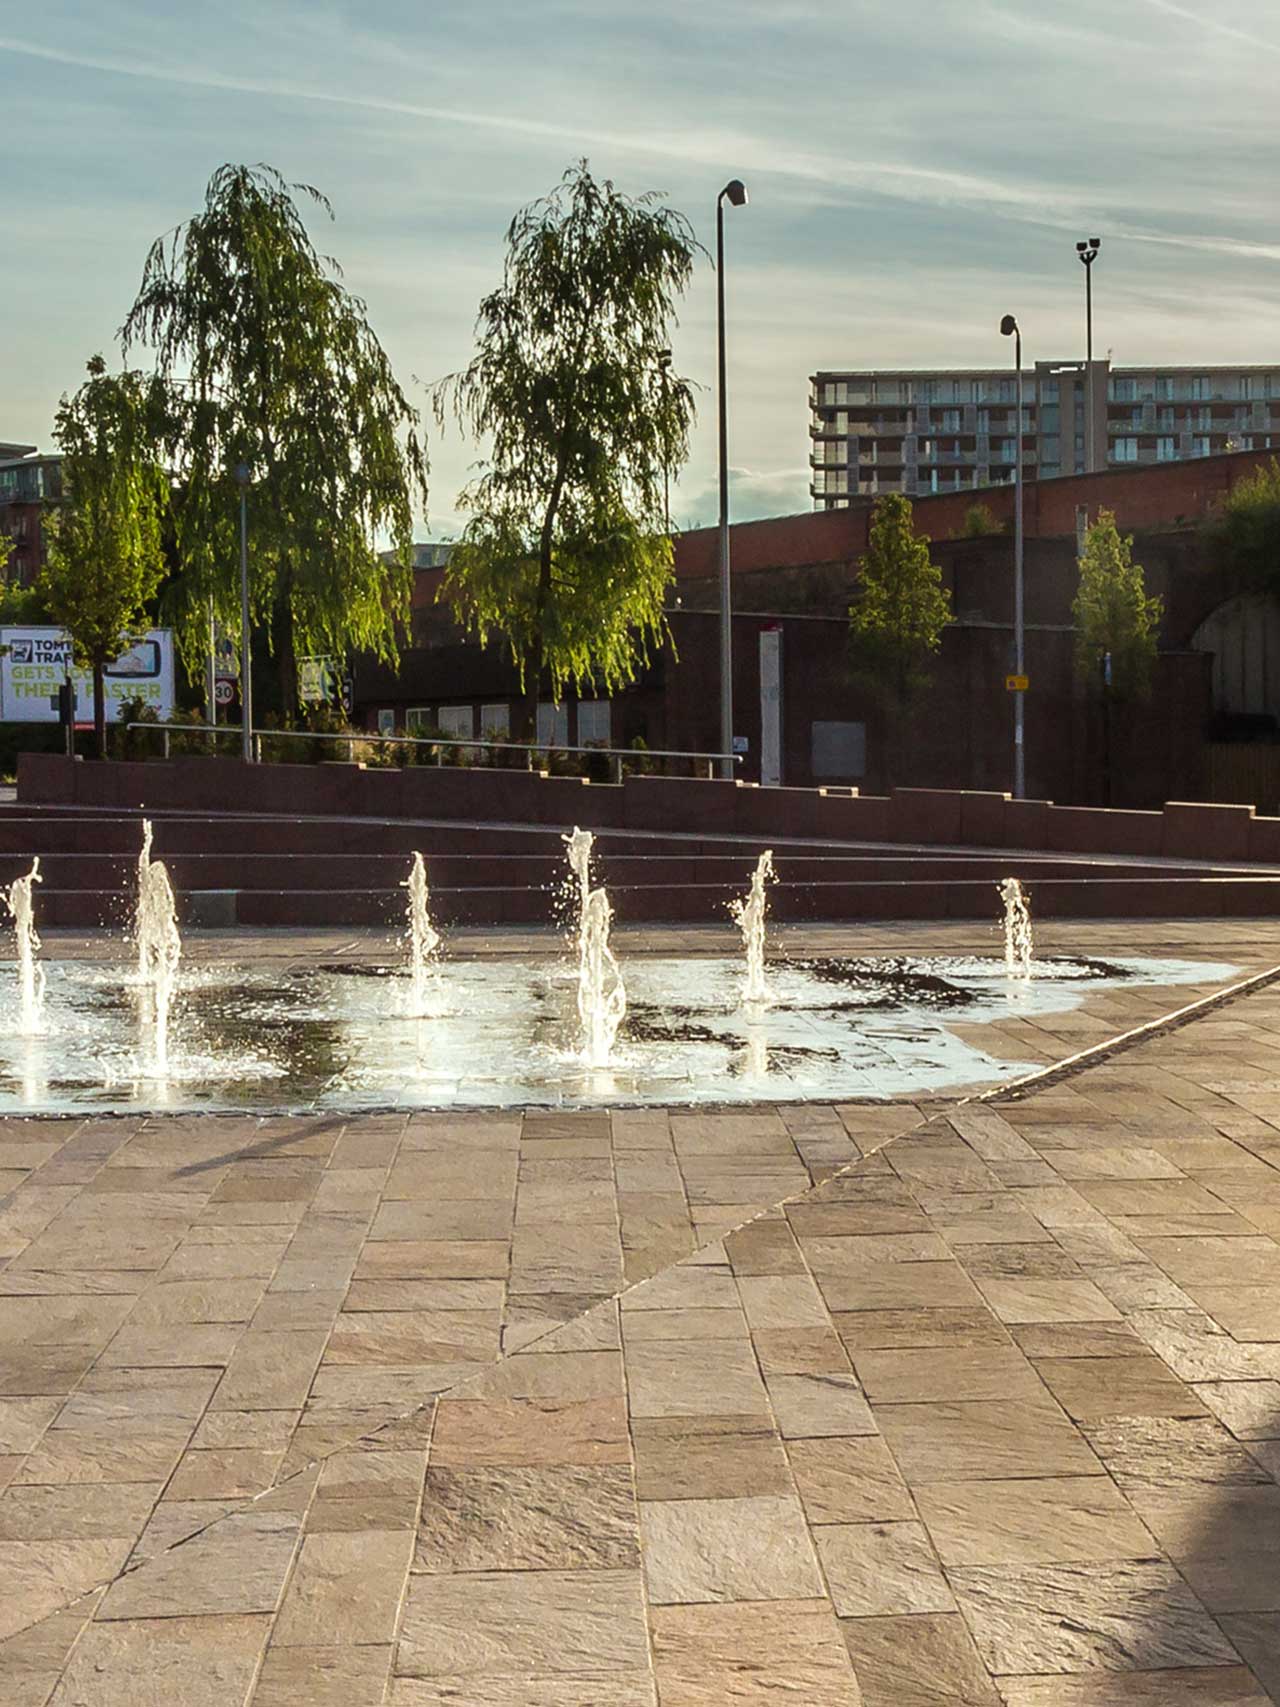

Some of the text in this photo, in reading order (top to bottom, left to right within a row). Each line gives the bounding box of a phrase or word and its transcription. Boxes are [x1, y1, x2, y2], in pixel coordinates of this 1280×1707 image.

[34, 640, 72, 651] TOMT
[34, 652, 72, 663] TRAF
[12, 665, 55, 679] GETS
[12, 682, 77, 698] THE
[215, 686, 232, 698] 30
